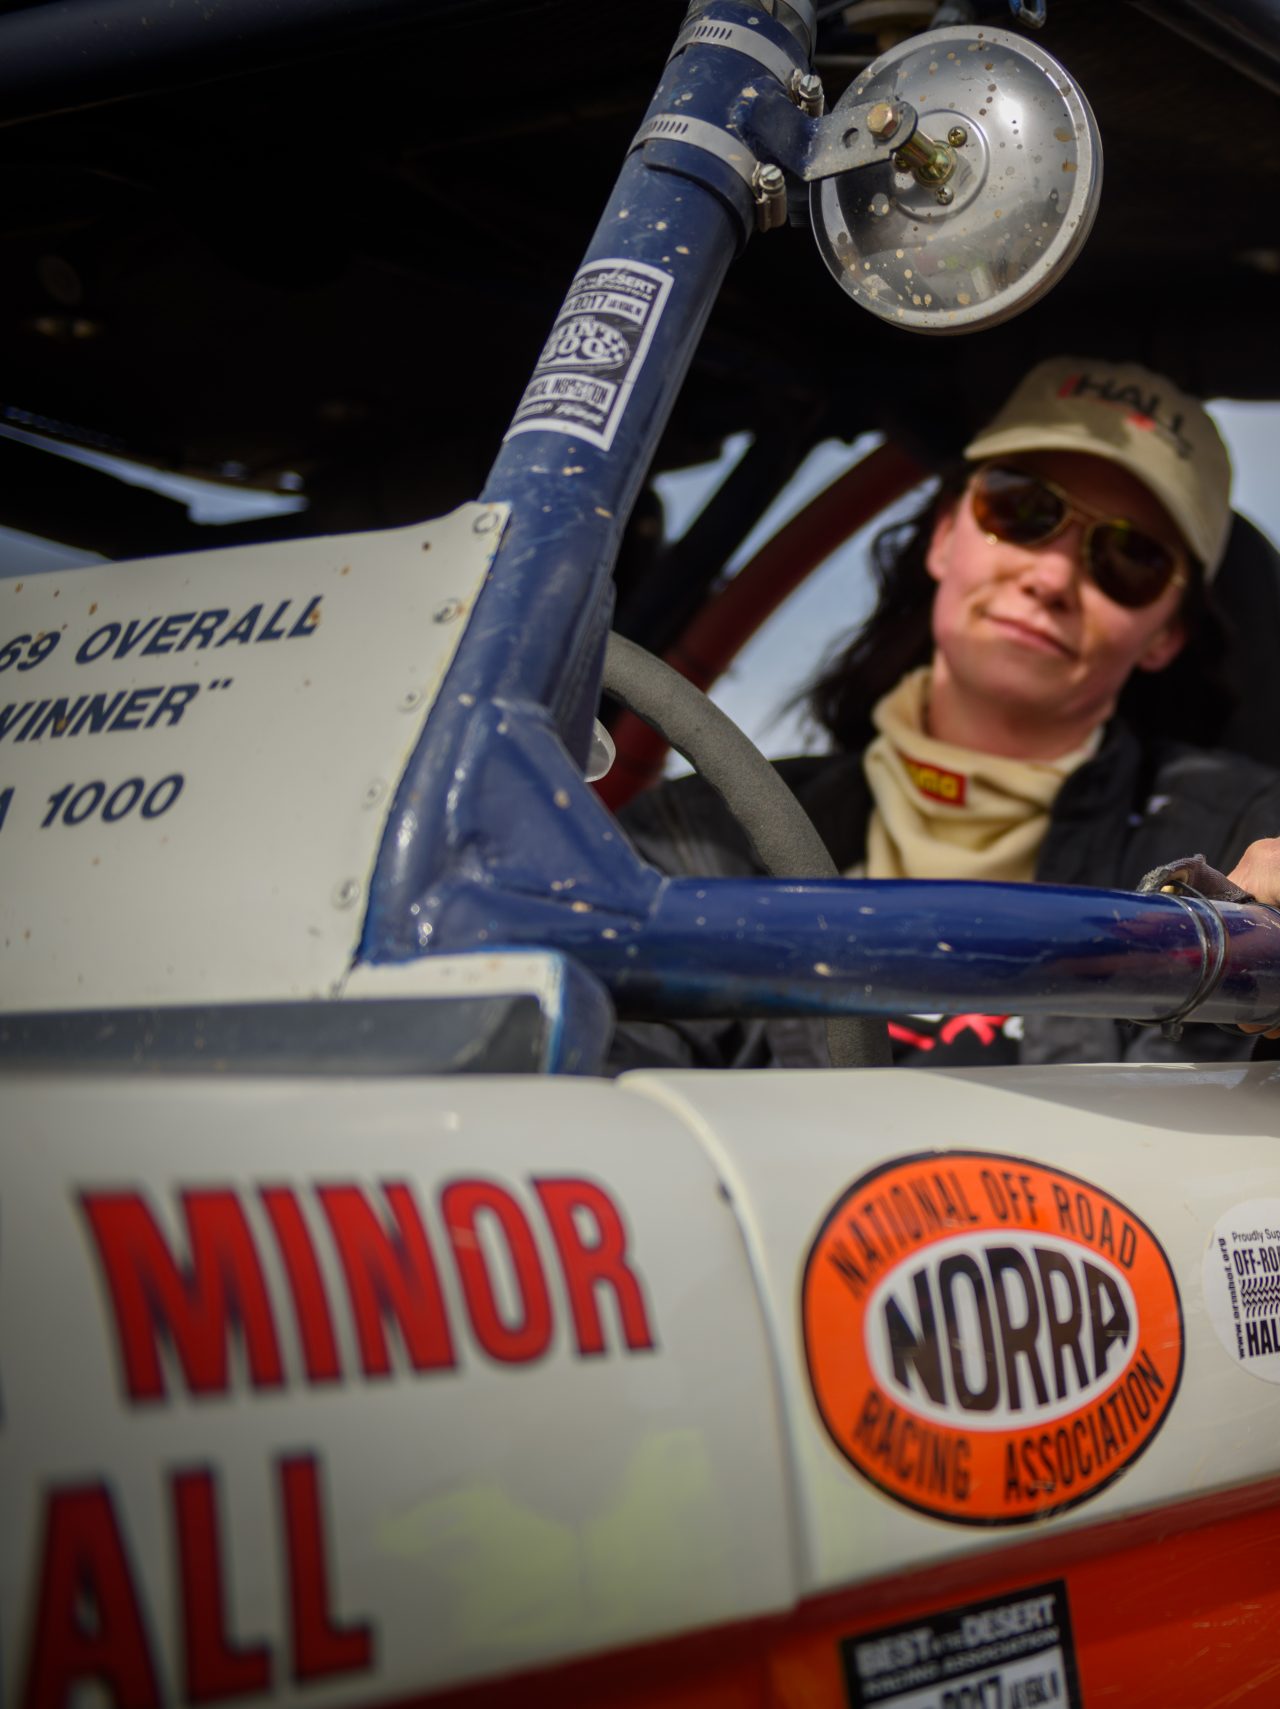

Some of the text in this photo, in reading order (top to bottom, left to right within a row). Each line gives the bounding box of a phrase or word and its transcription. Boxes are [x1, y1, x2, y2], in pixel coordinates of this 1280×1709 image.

[75, 594, 324, 665] OVERALL
[40, 774, 185, 829] 1000
[76, 1175, 658, 1406] MINOR
[827, 1168, 1137, 1298] NATIONAL OFF ROAD
[1232, 1230, 1264, 1243] Proudly
[884, 1246, 1130, 1412] NORRA
[853, 1350, 1166, 1504] RACING ASSOCIATION
